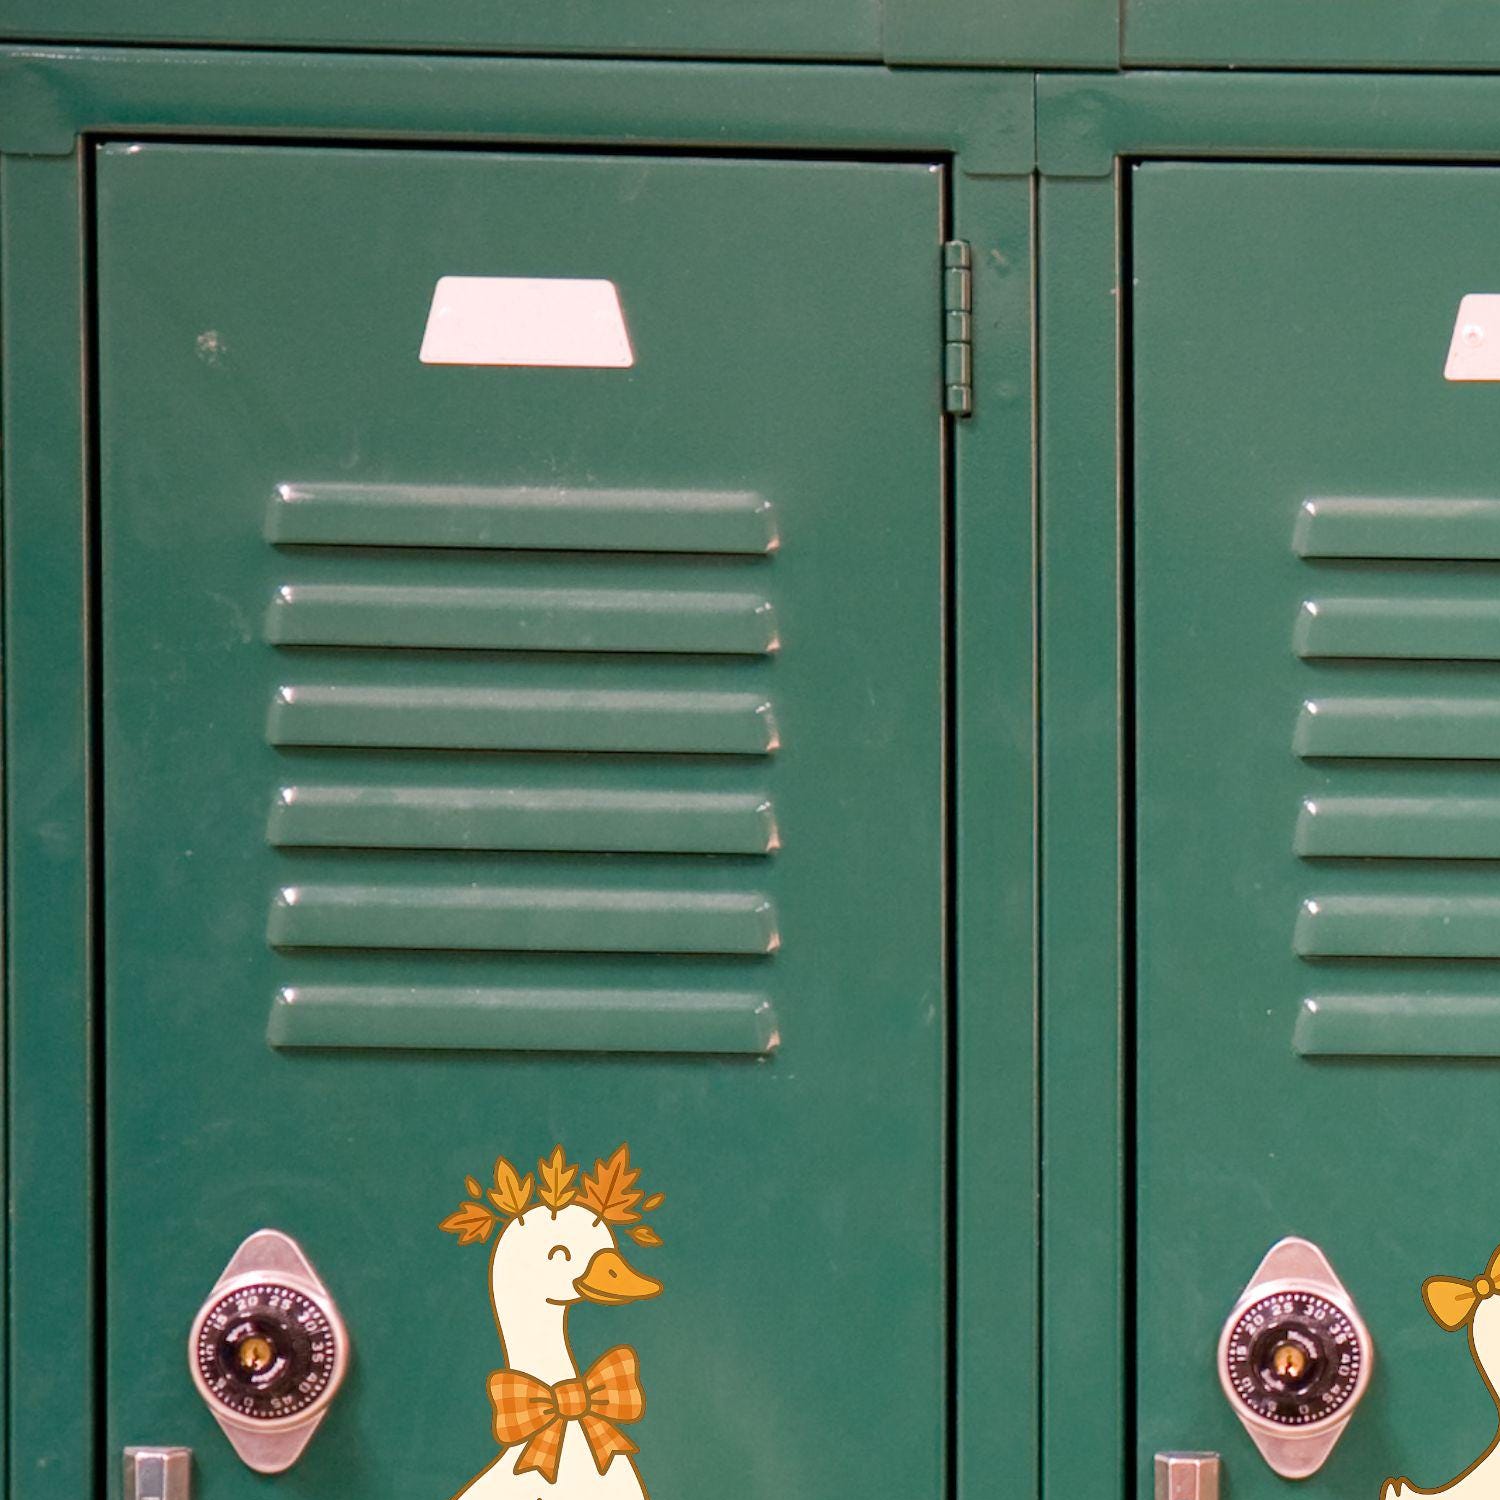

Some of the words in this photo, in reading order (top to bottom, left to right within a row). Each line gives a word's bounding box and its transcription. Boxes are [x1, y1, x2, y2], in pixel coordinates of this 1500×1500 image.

[235, 1296, 258, 1311] 20
[269, 1295, 292, 1310] 25
[1272, 1302, 1294, 1316] 25
[1304, 1304, 1326, 1321] 30
[1245, 1314, 1264, 1335] 20
[312, 1341, 324, 1363] 35
